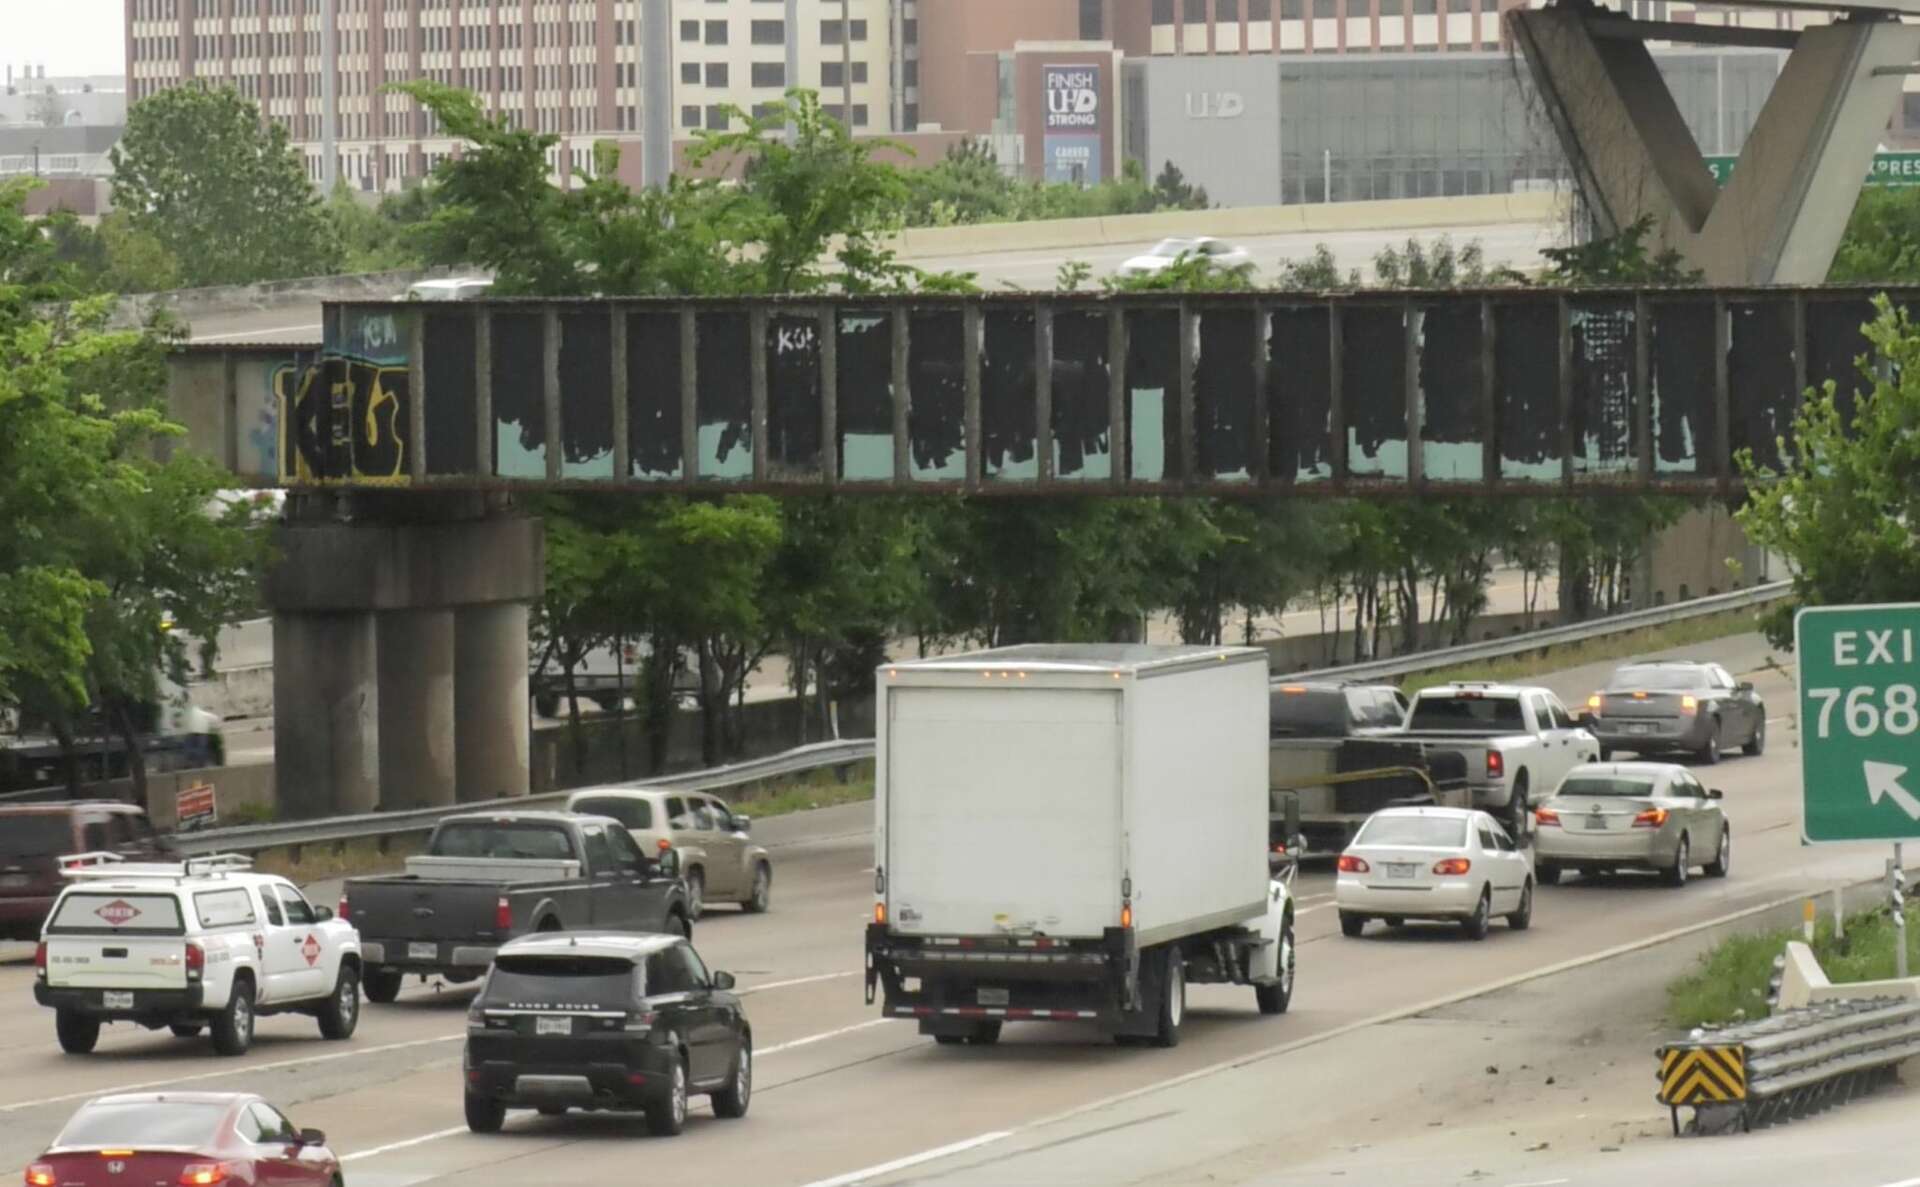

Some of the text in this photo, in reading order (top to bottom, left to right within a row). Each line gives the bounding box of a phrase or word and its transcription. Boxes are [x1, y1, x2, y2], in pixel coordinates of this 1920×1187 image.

[1048, 72, 1093, 88] FINISH
[1048, 88, 1097, 113] UHD
[1048, 114, 1096, 125] STRONG
[1834, 629, 1913, 666] EXI
[1808, 684, 1919, 738] 768
[508, 1002, 599, 1011] RANGE ROVER
